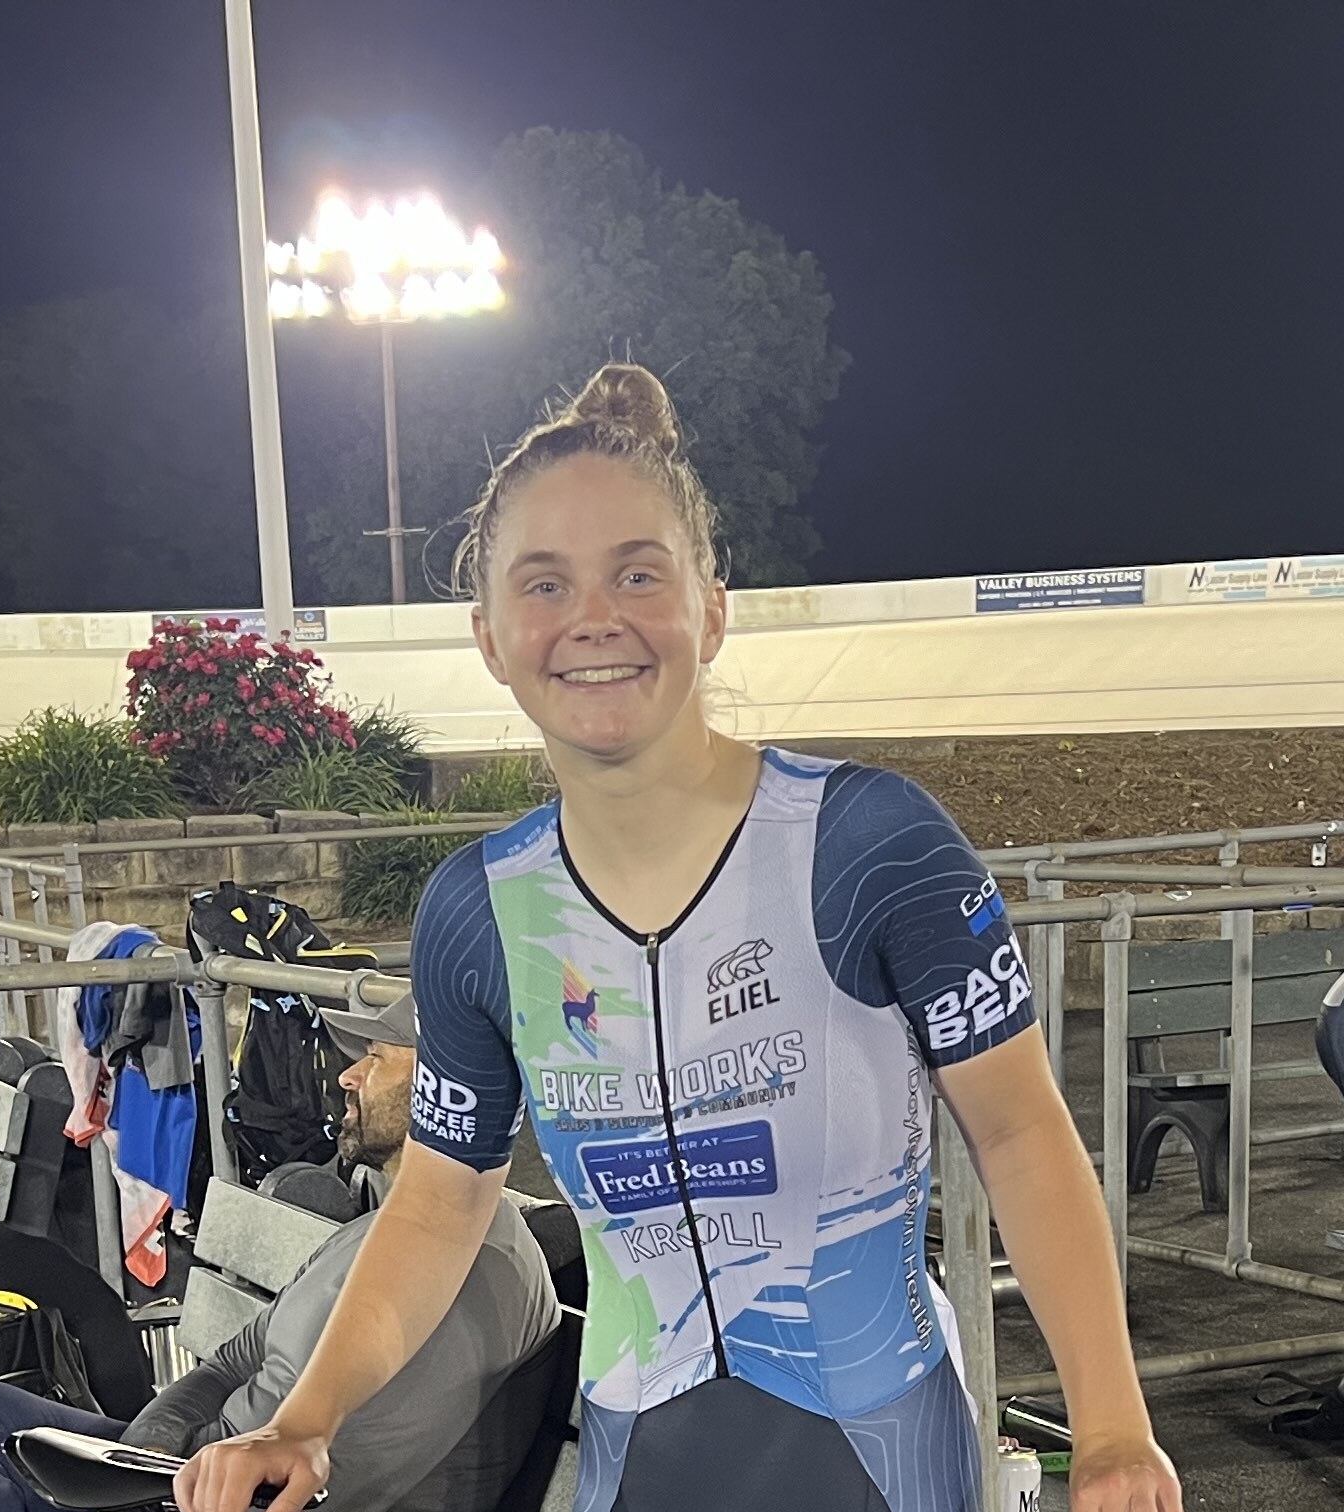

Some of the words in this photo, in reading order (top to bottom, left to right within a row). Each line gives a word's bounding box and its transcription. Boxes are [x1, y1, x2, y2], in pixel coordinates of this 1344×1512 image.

[978, 578, 1024, 590] VALLEY
[1025, 574, 1086, 588] BUSINESS
[1087, 570, 1142, 585] SYSTEMS
[708, 978, 781, 1025] ELIEL
[927, 963, 1032, 1050] BEA
[413, 1060, 478, 1113] RD
[540, 1069, 623, 1112] BIKE
[636, 1030, 806, 1110] WORKS
[412, 1106, 476, 1144] OMPANY
[609, 1114, 670, 1130] SERVIC
[698, 1081, 797, 1116] COMMUNITY
[618, 1150, 642, 1161] IT'S
[702, 1137, 720, 1148] AT
[903, 1067, 924, 1247] Doylestown
[596, 1163, 662, 1195] Fred
[664, 1157, 766, 1185] Beans
[621, 1189, 654, 1202] FAMILY
[621, 1212, 782, 1263] KROLL
[903, 1253, 934, 1351] Health
